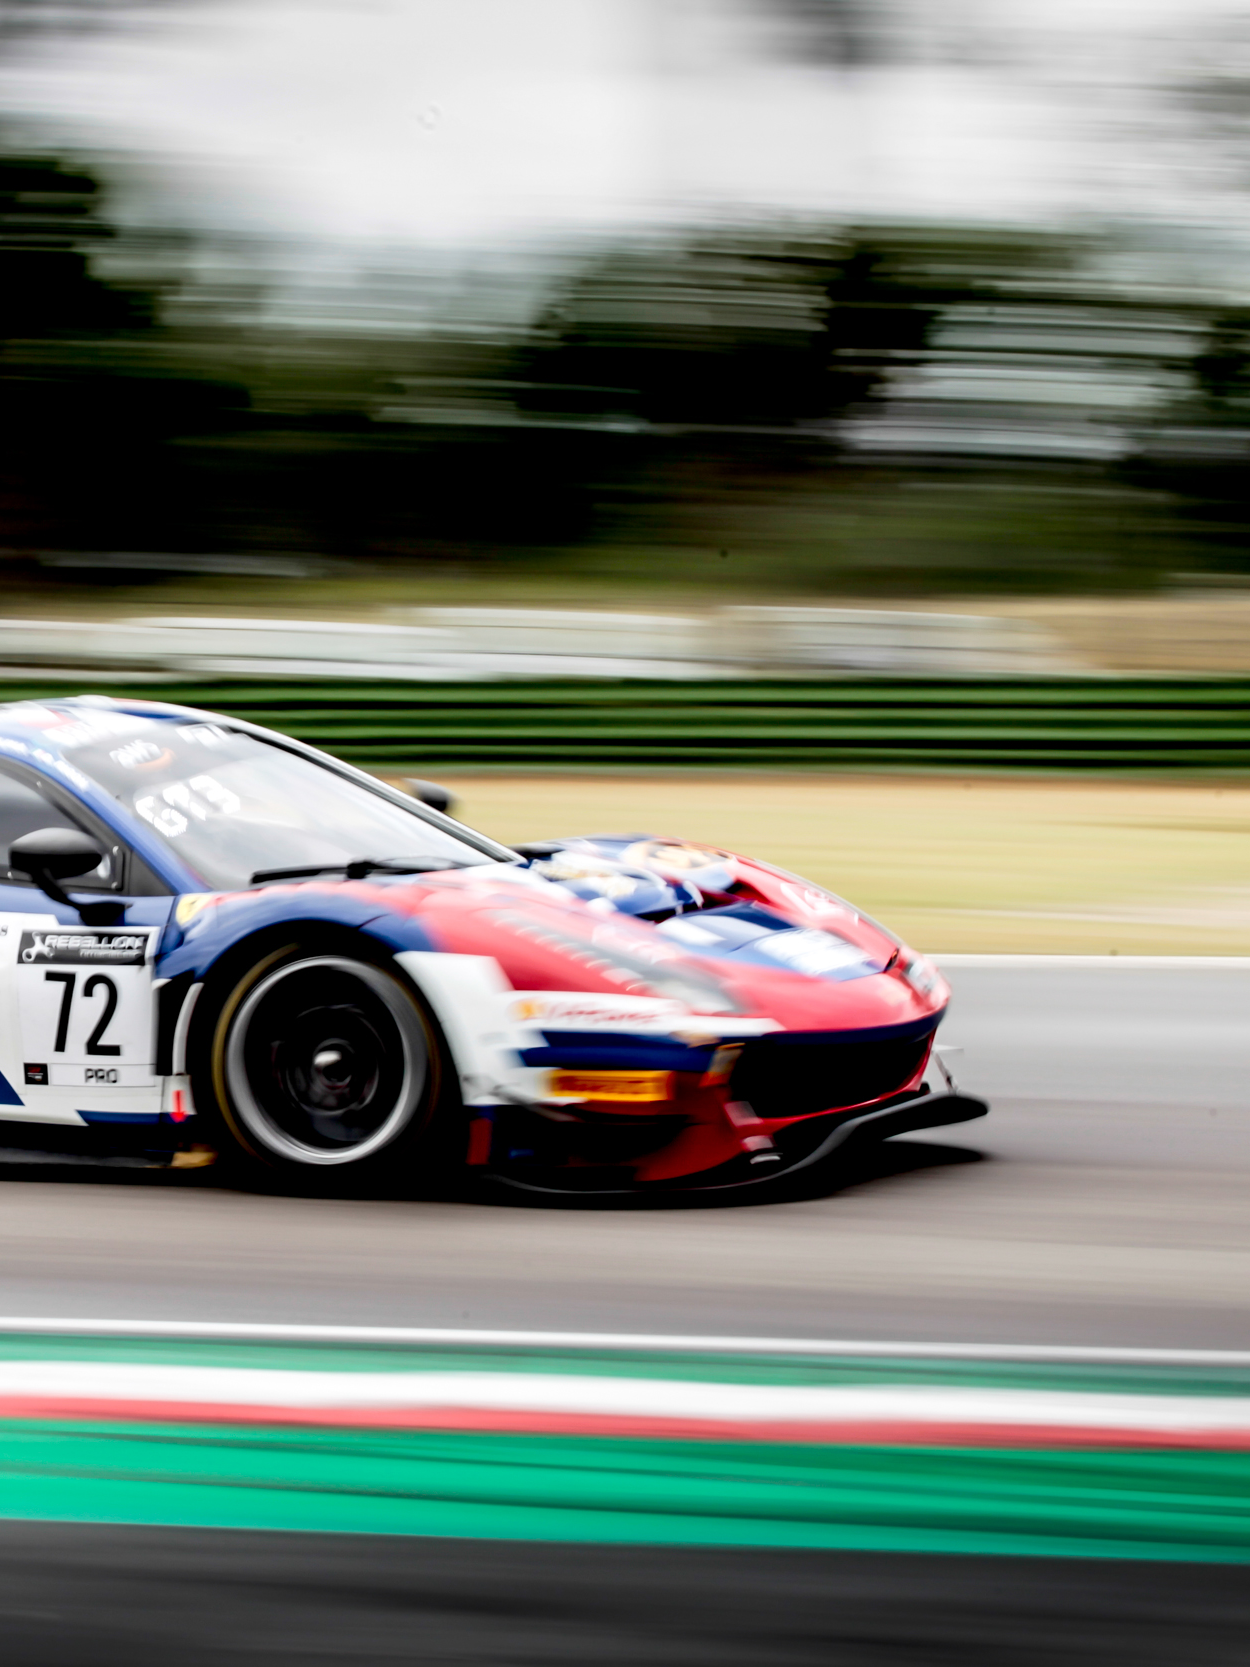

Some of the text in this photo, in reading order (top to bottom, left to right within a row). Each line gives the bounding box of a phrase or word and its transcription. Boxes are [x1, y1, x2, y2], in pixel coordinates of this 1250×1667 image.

[45, 934, 144, 950] REBELLION
[44, 969, 121, 1056] 72
[84, 1067, 118, 1084] PRO
